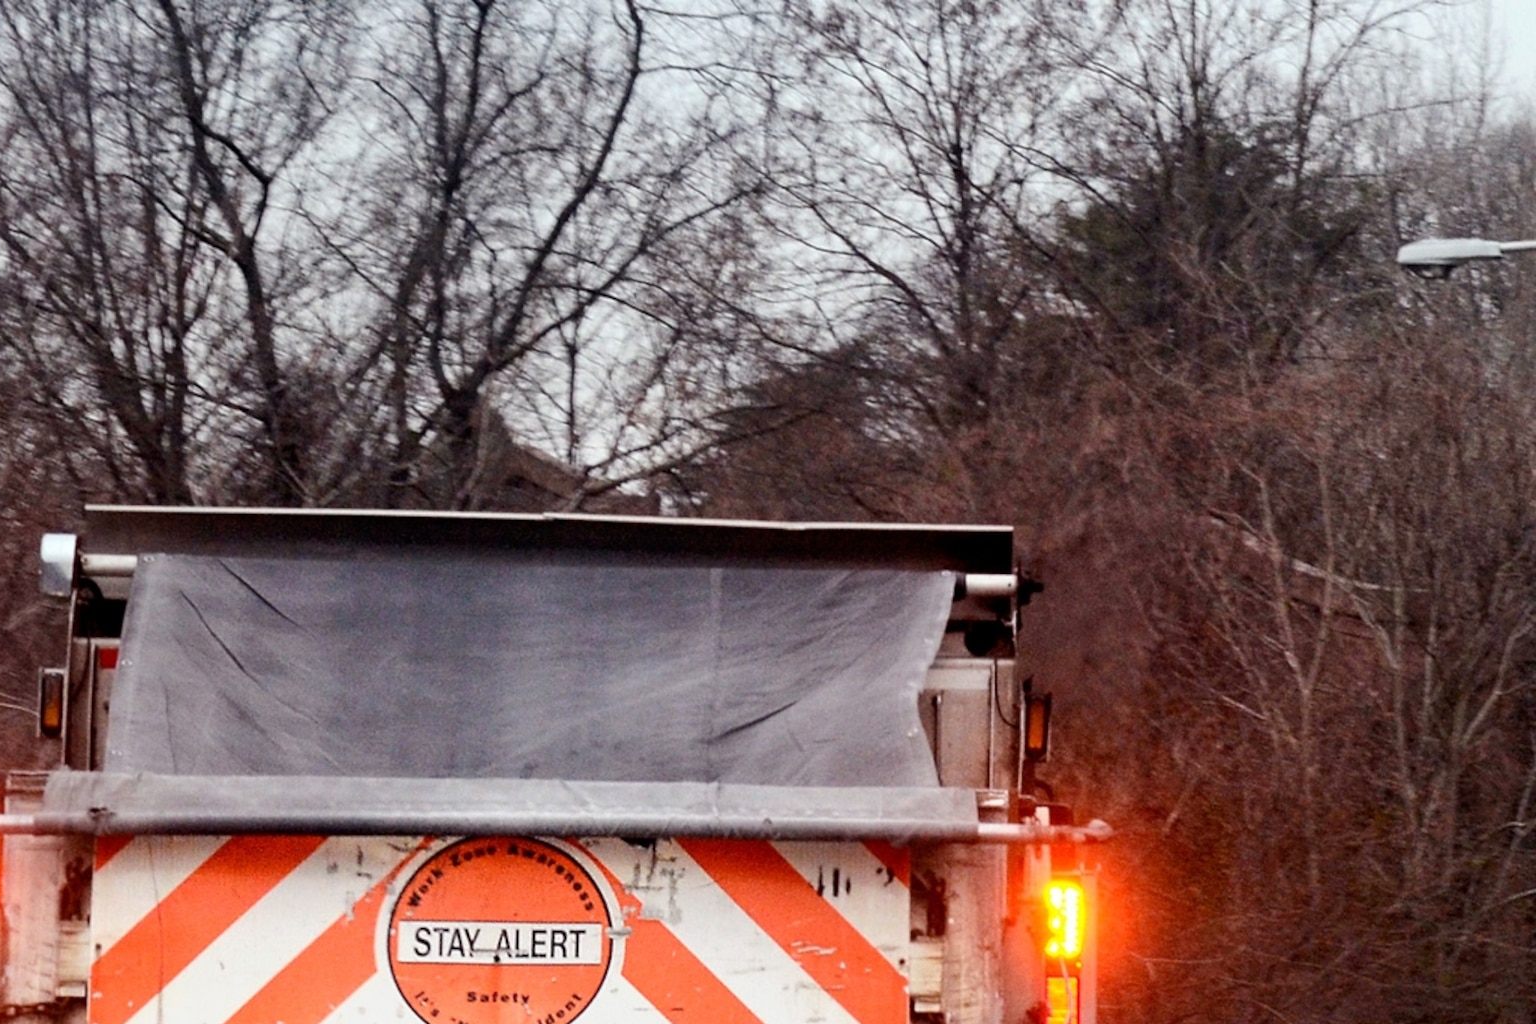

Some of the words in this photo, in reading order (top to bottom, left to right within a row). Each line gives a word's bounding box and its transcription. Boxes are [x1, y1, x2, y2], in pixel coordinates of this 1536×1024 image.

[407, 865, 444, 908] Work
[451, 845, 498, 868] Zone
[507, 844, 594, 912] Awareness
[413, 926, 481, 957] STAY
[495, 928, 587, 959] ALERT
[415, 990, 441, 1019] It's
[467, 991, 531, 1006] Safety
